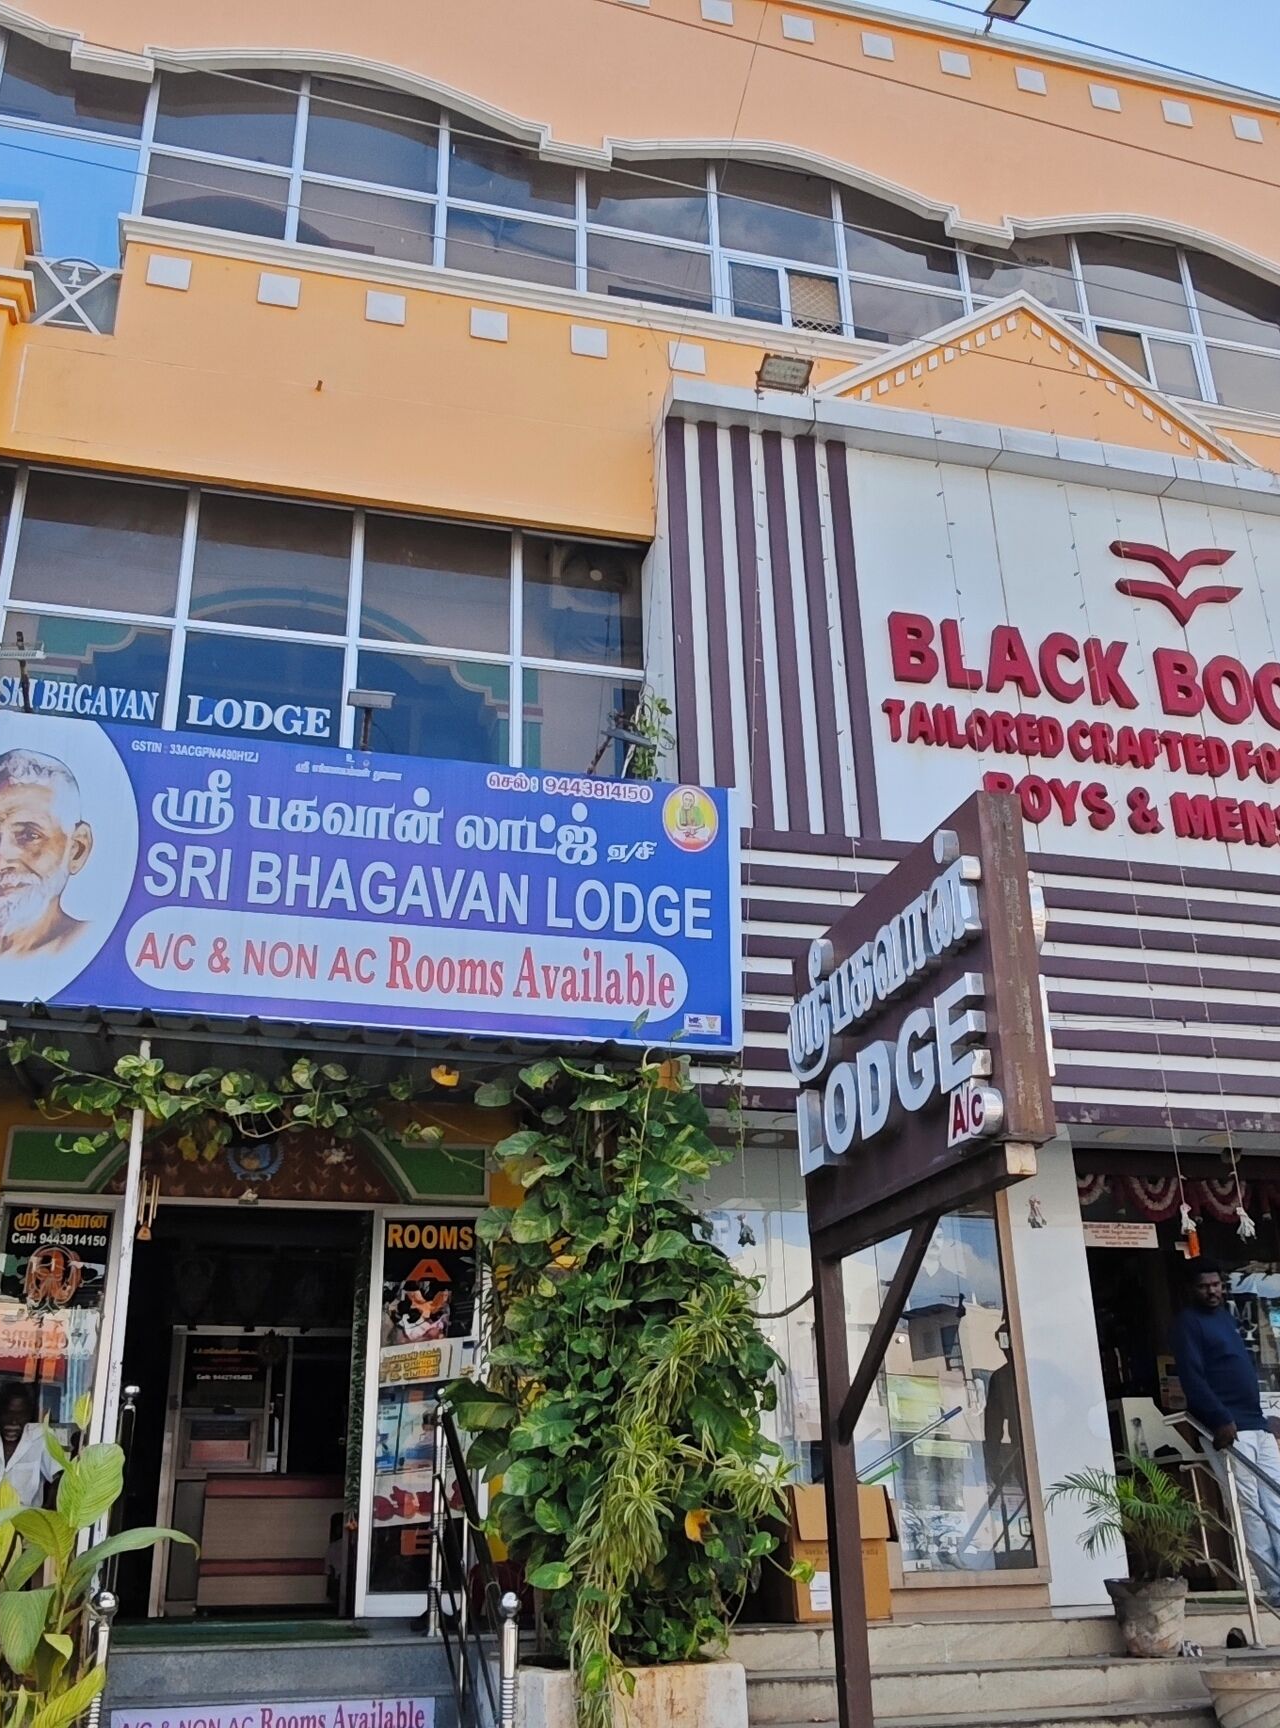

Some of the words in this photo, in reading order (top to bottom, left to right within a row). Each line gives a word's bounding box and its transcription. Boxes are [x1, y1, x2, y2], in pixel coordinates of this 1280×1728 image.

[888, 611, 1140, 710] BLACK
[40, 680, 159, 722] BHGAVAN
[185, 693, 332, 738] LODGE
[881, 698, 1064, 758] TAILORED
[1066, 720, 1230, 778] CRAFTED
[131, 739, 163, 754] GSTIN
[151, 769, 235, 835] ஸ்ரீ
[247, 787, 445, 845] பகவான்
[455, 802, 599, 867] லாட்ஜ்
[544, 777, 653, 804] 9443814150
[1126, 787, 1163, 835] &
[143, 842, 232, 902] SRI
[246, 850, 530, 925] BHAGAVAN
[546, 876, 713, 940] LODGE
[135, 932, 197, 971] A/C
[207, 937, 231, 975] &
[243, 939, 319, 980] NON
[327, 946, 377, 984] AC
[385, 936, 505, 998] Rooms
[512, 946, 675, 1009] Available
[796, 972, 992, 1177] LODGE
[12, 1232, 37, 1243] Cell:
[39, 1233, 107, 1247] 9443814150
[387, 1224, 474, 1250] ROOMS
[333, 1701, 425, 1728] Available
